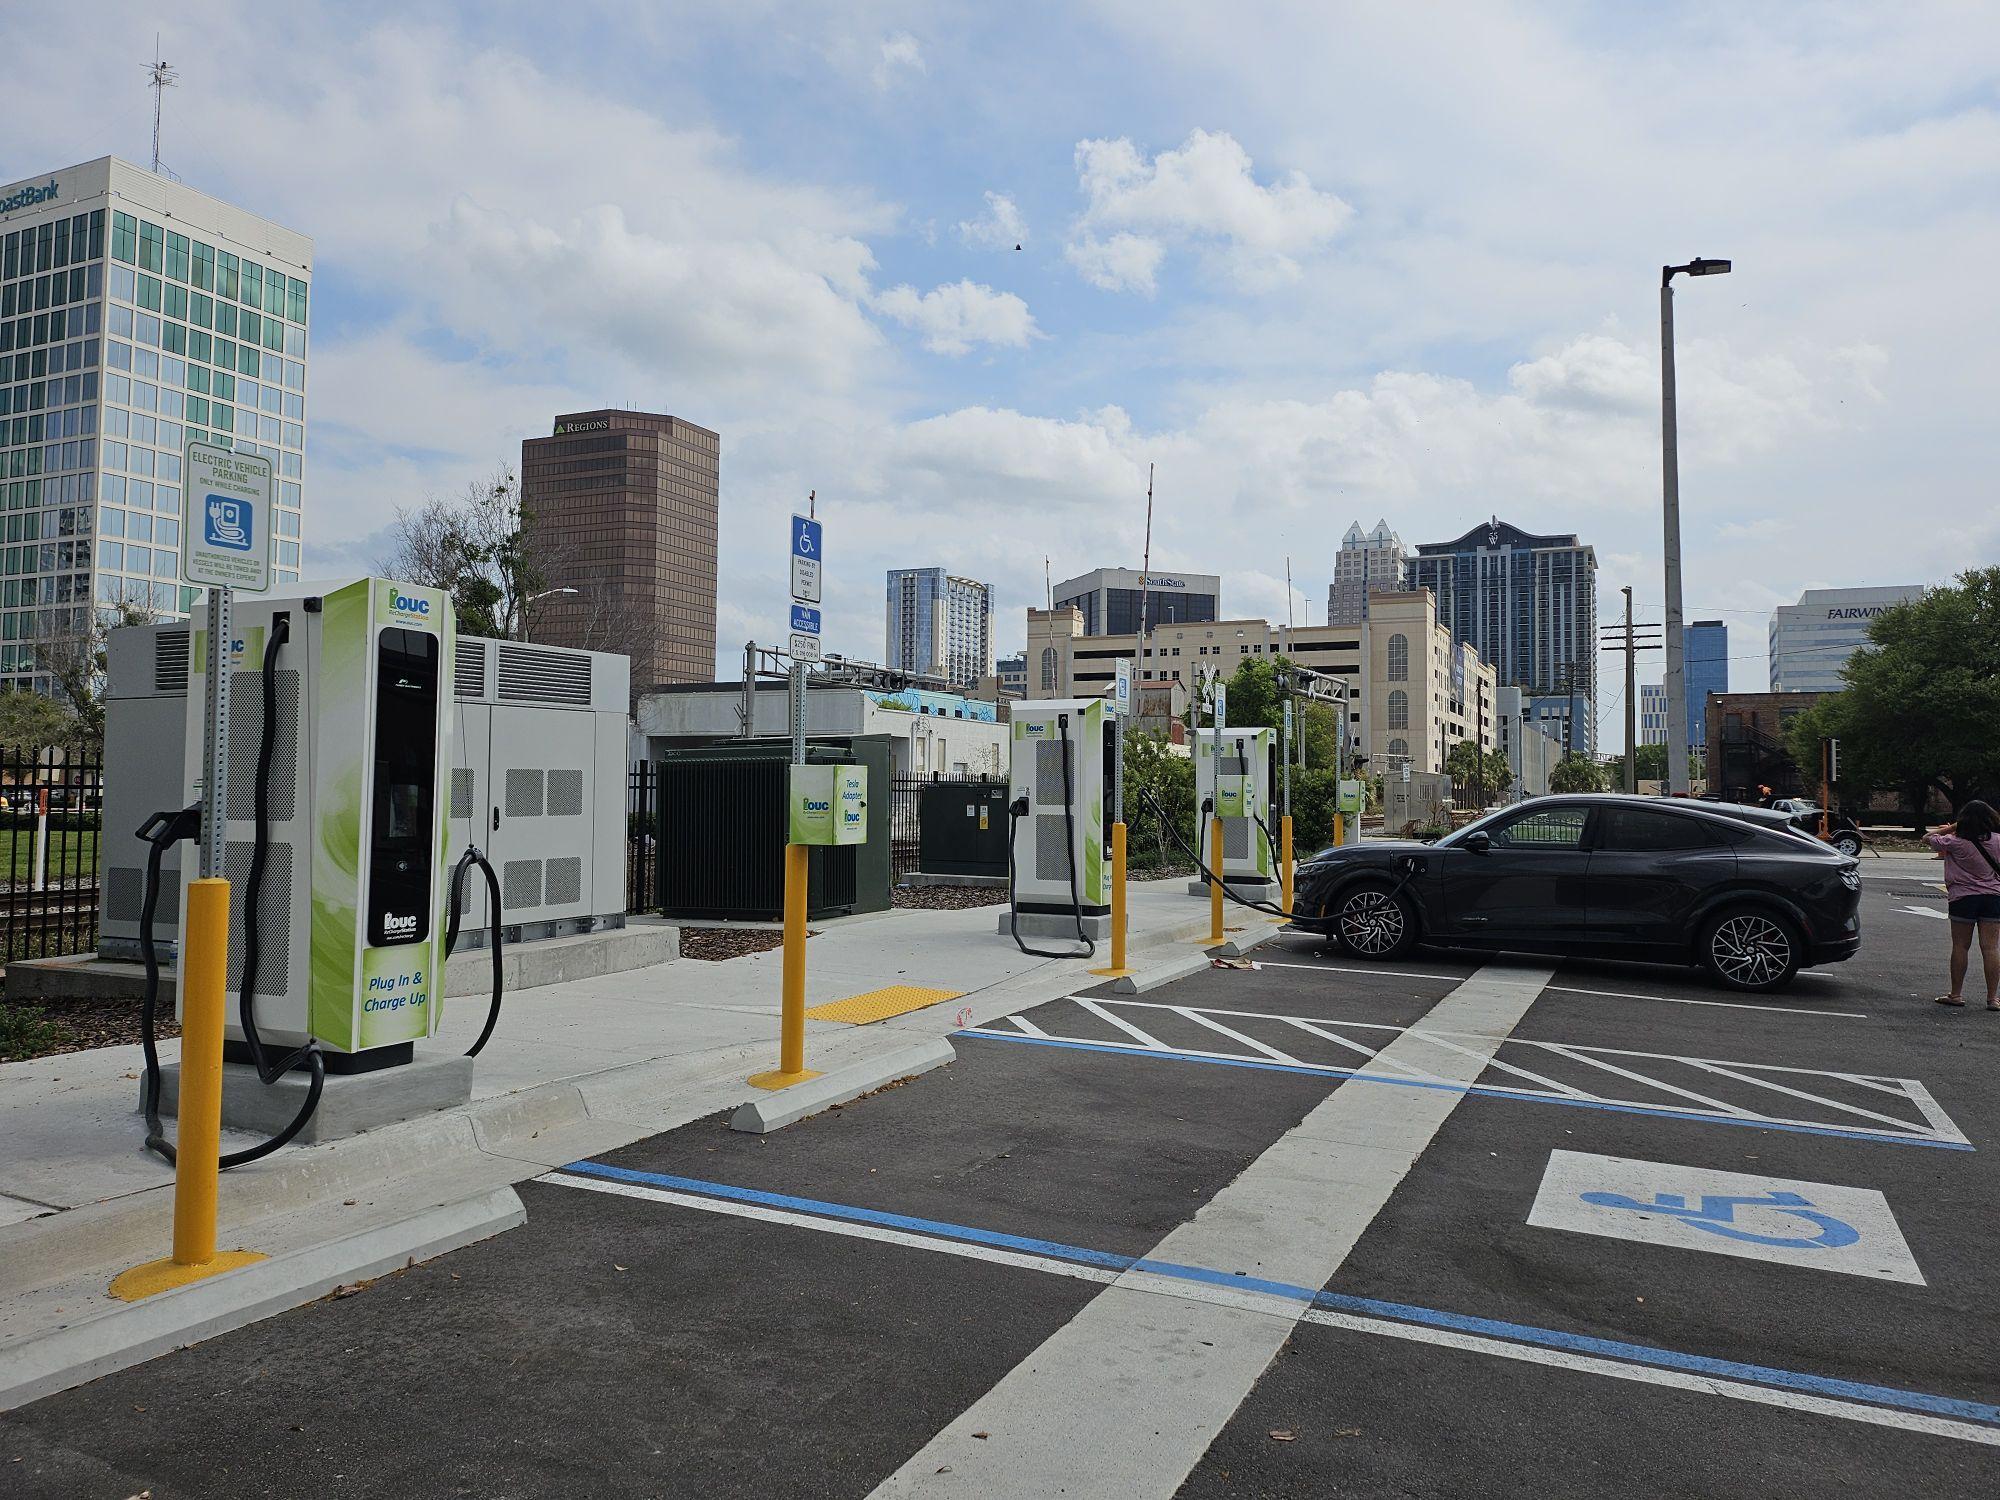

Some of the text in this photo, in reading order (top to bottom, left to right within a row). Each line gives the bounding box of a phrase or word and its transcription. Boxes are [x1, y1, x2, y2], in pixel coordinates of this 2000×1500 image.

[192, 451, 268, 478] ELECTRIC VEHICLE
[212, 467, 248, 484] PARKING
[199, 477, 260, 496] ONLY WHILE CHARGING
[846, 780, 860, 788] Tesla
[842, 791, 863, 802] Adapter
[369, 971, 422, 991] Plug In &
[364, 991, 426, 1012] Charge Up
